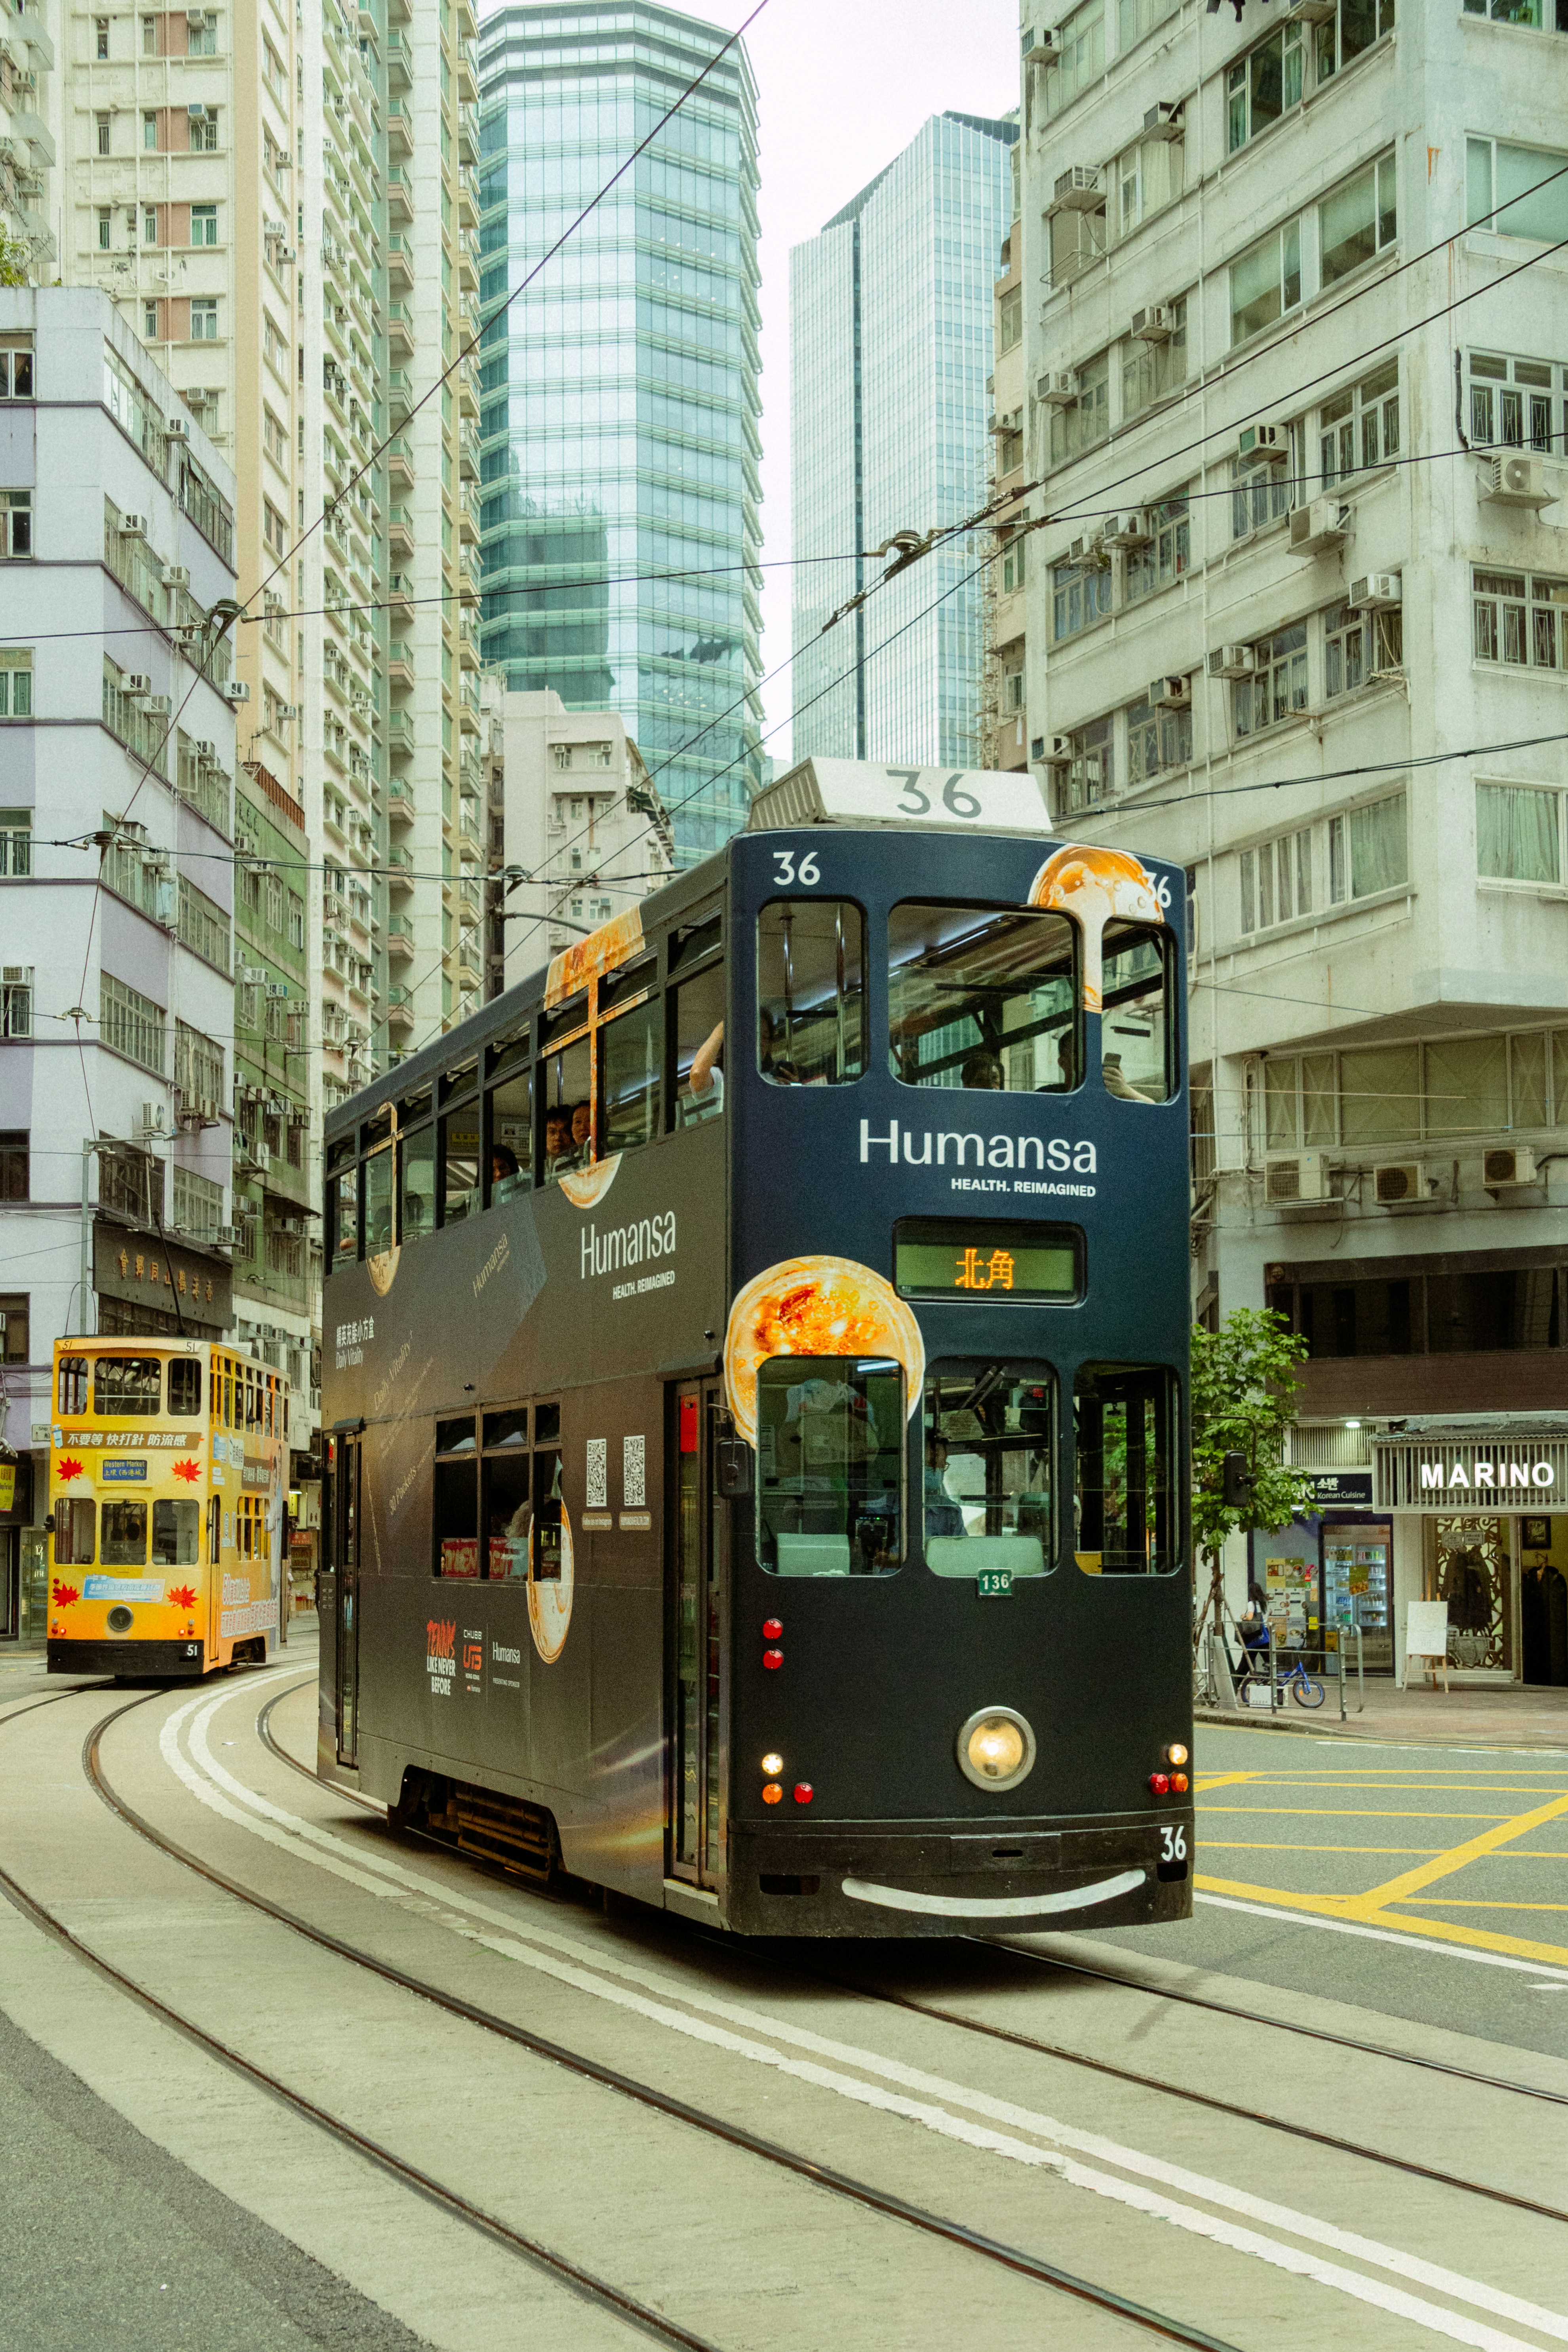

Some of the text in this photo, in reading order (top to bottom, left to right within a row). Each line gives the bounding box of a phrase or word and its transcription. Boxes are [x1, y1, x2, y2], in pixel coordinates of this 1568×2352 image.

[885, 769, 982, 818] 36
[773, 851, 820, 886] 36
[1142, 872, 1172, 909] 36
[859, 1119, 1097, 1174] Humansa
[951, 1178, 1096, 1198] HEALTH. REIMAGINED
[581, 1210, 676, 1279] Humansa
[472, 1233, 508, 1298] Humansa
[955, 1248, 1014, 1290] 北角
[613, 1270, 675, 1300] HEALTH. REIMAGINED
[337, 1315, 374, 1349] 精英充能小方盒
[62, 1341, 72, 1350] 51
[185, 1342, 195, 1353] 51
[336, 1346, 363, 1371] Daily Vitality
[67, 1433, 187, 1446] 不要等 快打針 防流感
[1317, 1477, 1338, 1491] 소반
[1421, 1462, 1555, 1488] MARINO
[389, 1466, 417, 1515] 30 Packets
[982, 1574, 1009, 1590] 136
[463, 1629, 482, 1640] CHUBB
[186, 1644, 198, 1656] 51
[493, 1641, 520, 1664] Humansa
[427, 1656, 456, 1677] LIKE NEVER
[431, 1676, 451, 1696] BEFORE
[1160, 1825, 1187, 1863] 36
